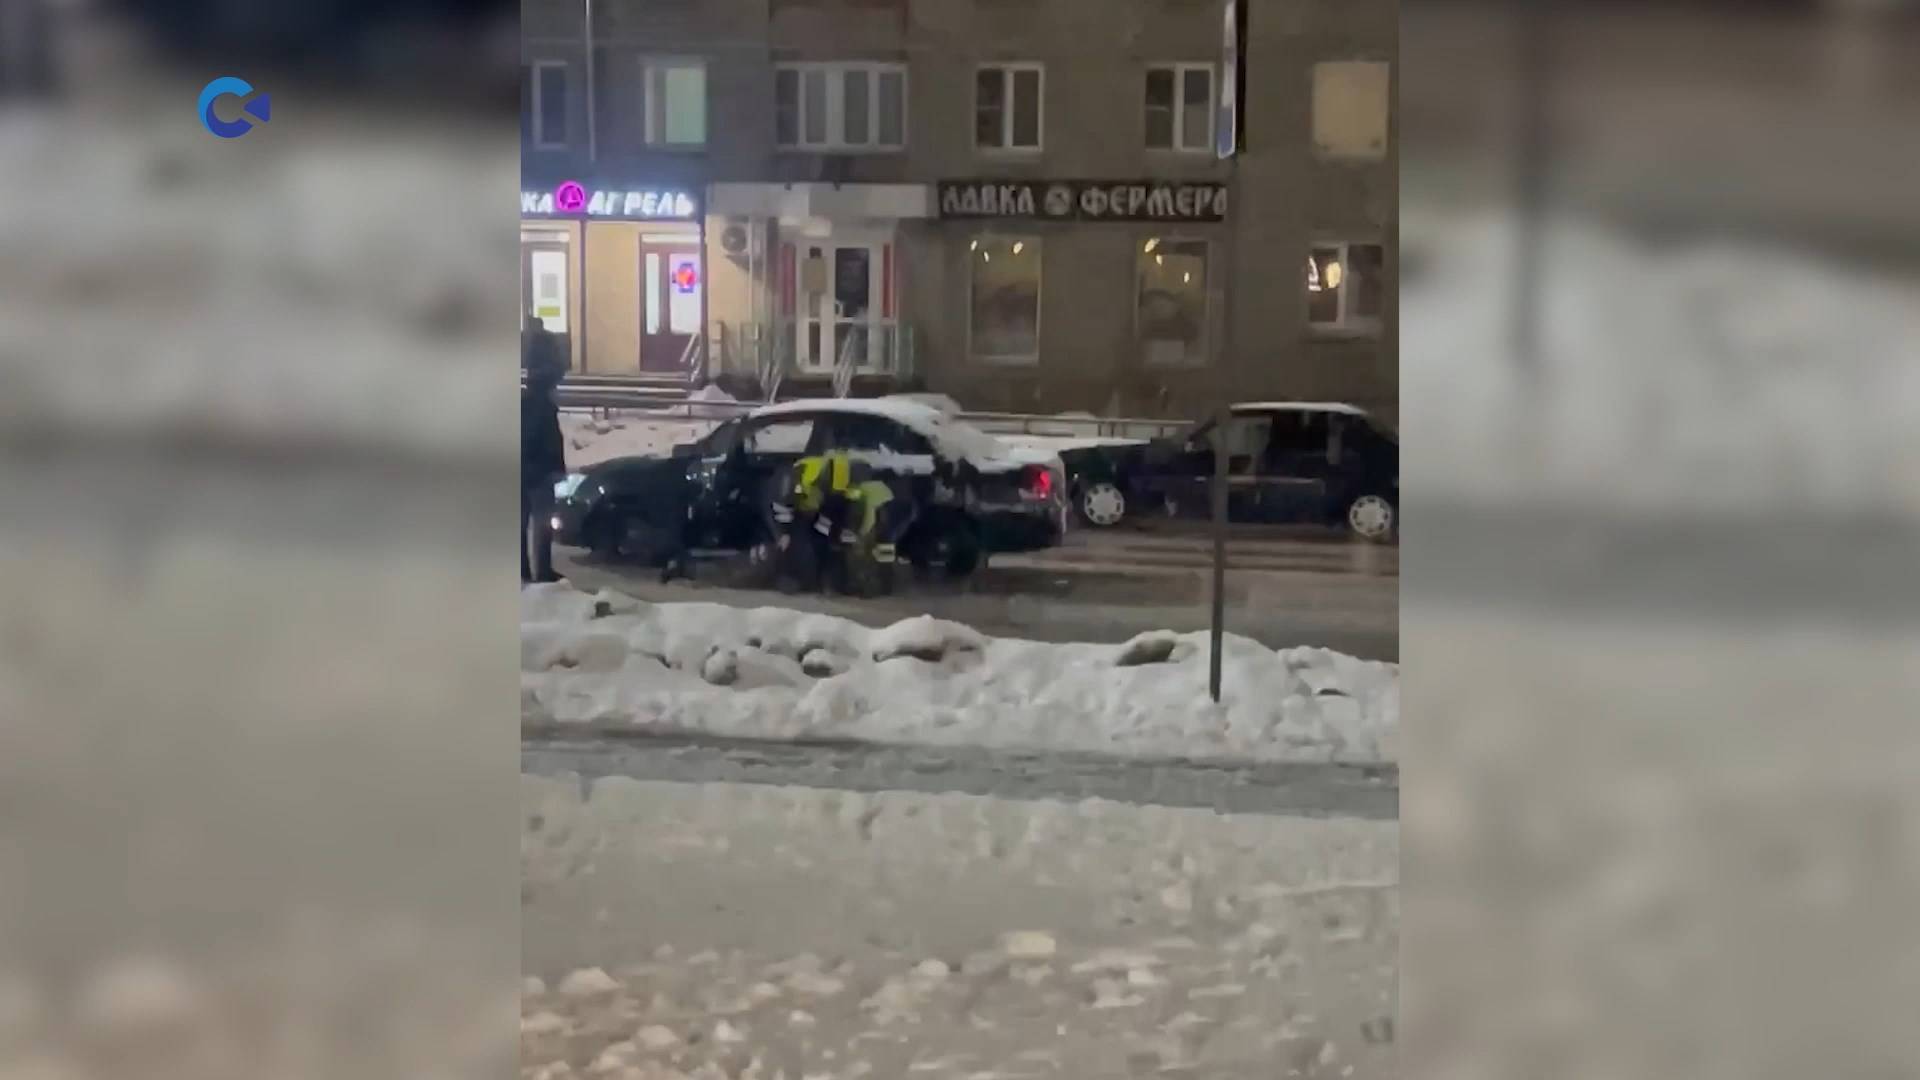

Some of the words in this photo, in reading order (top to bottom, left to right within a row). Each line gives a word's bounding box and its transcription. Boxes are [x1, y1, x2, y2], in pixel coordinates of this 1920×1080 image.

[587, 190, 695, 216] АГРЕЛЬ
[943, 184, 1035, 215] ЛАВКА
[1080, 185, 1228, 216] ФЕРМЕРА
